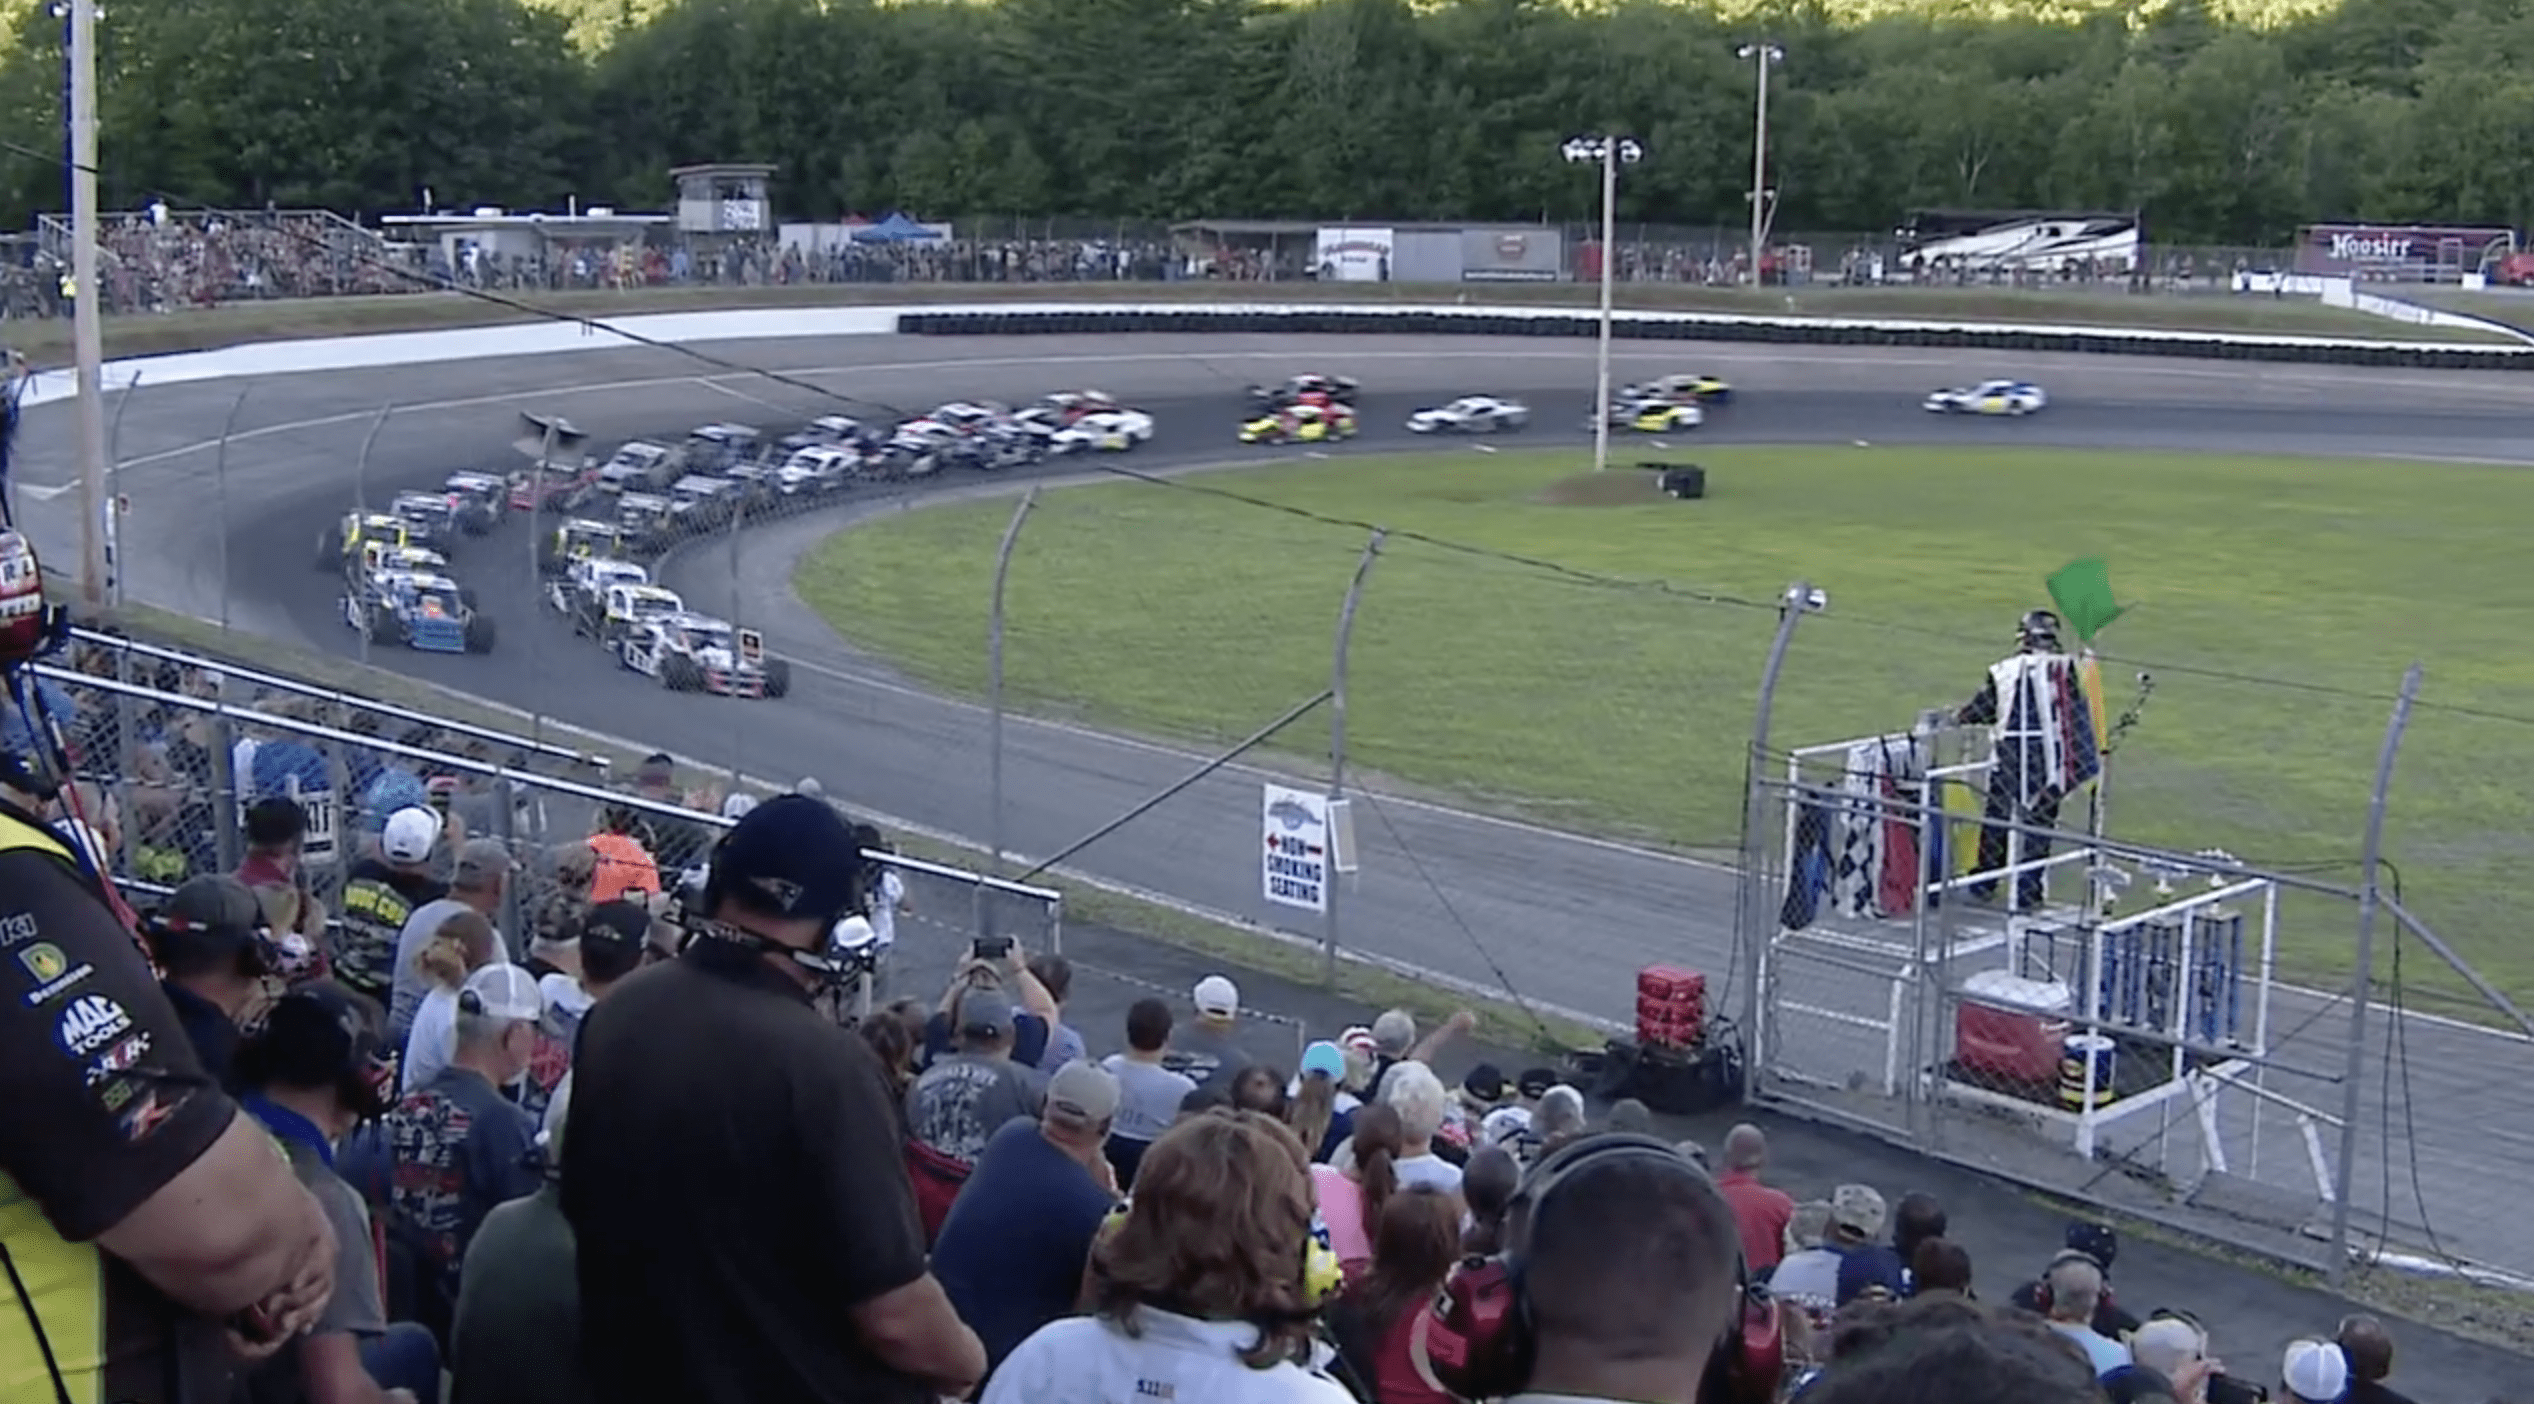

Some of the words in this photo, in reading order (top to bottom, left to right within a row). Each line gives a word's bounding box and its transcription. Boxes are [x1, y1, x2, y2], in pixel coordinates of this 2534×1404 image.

[1281, 836, 1305, 856] NON
[1267, 853, 1321, 882] SMOKING
[1269, 875, 1319, 903] SEATING
[61, 995, 125, 1047] MAC
[71, 1013, 133, 1055] TOOLS
